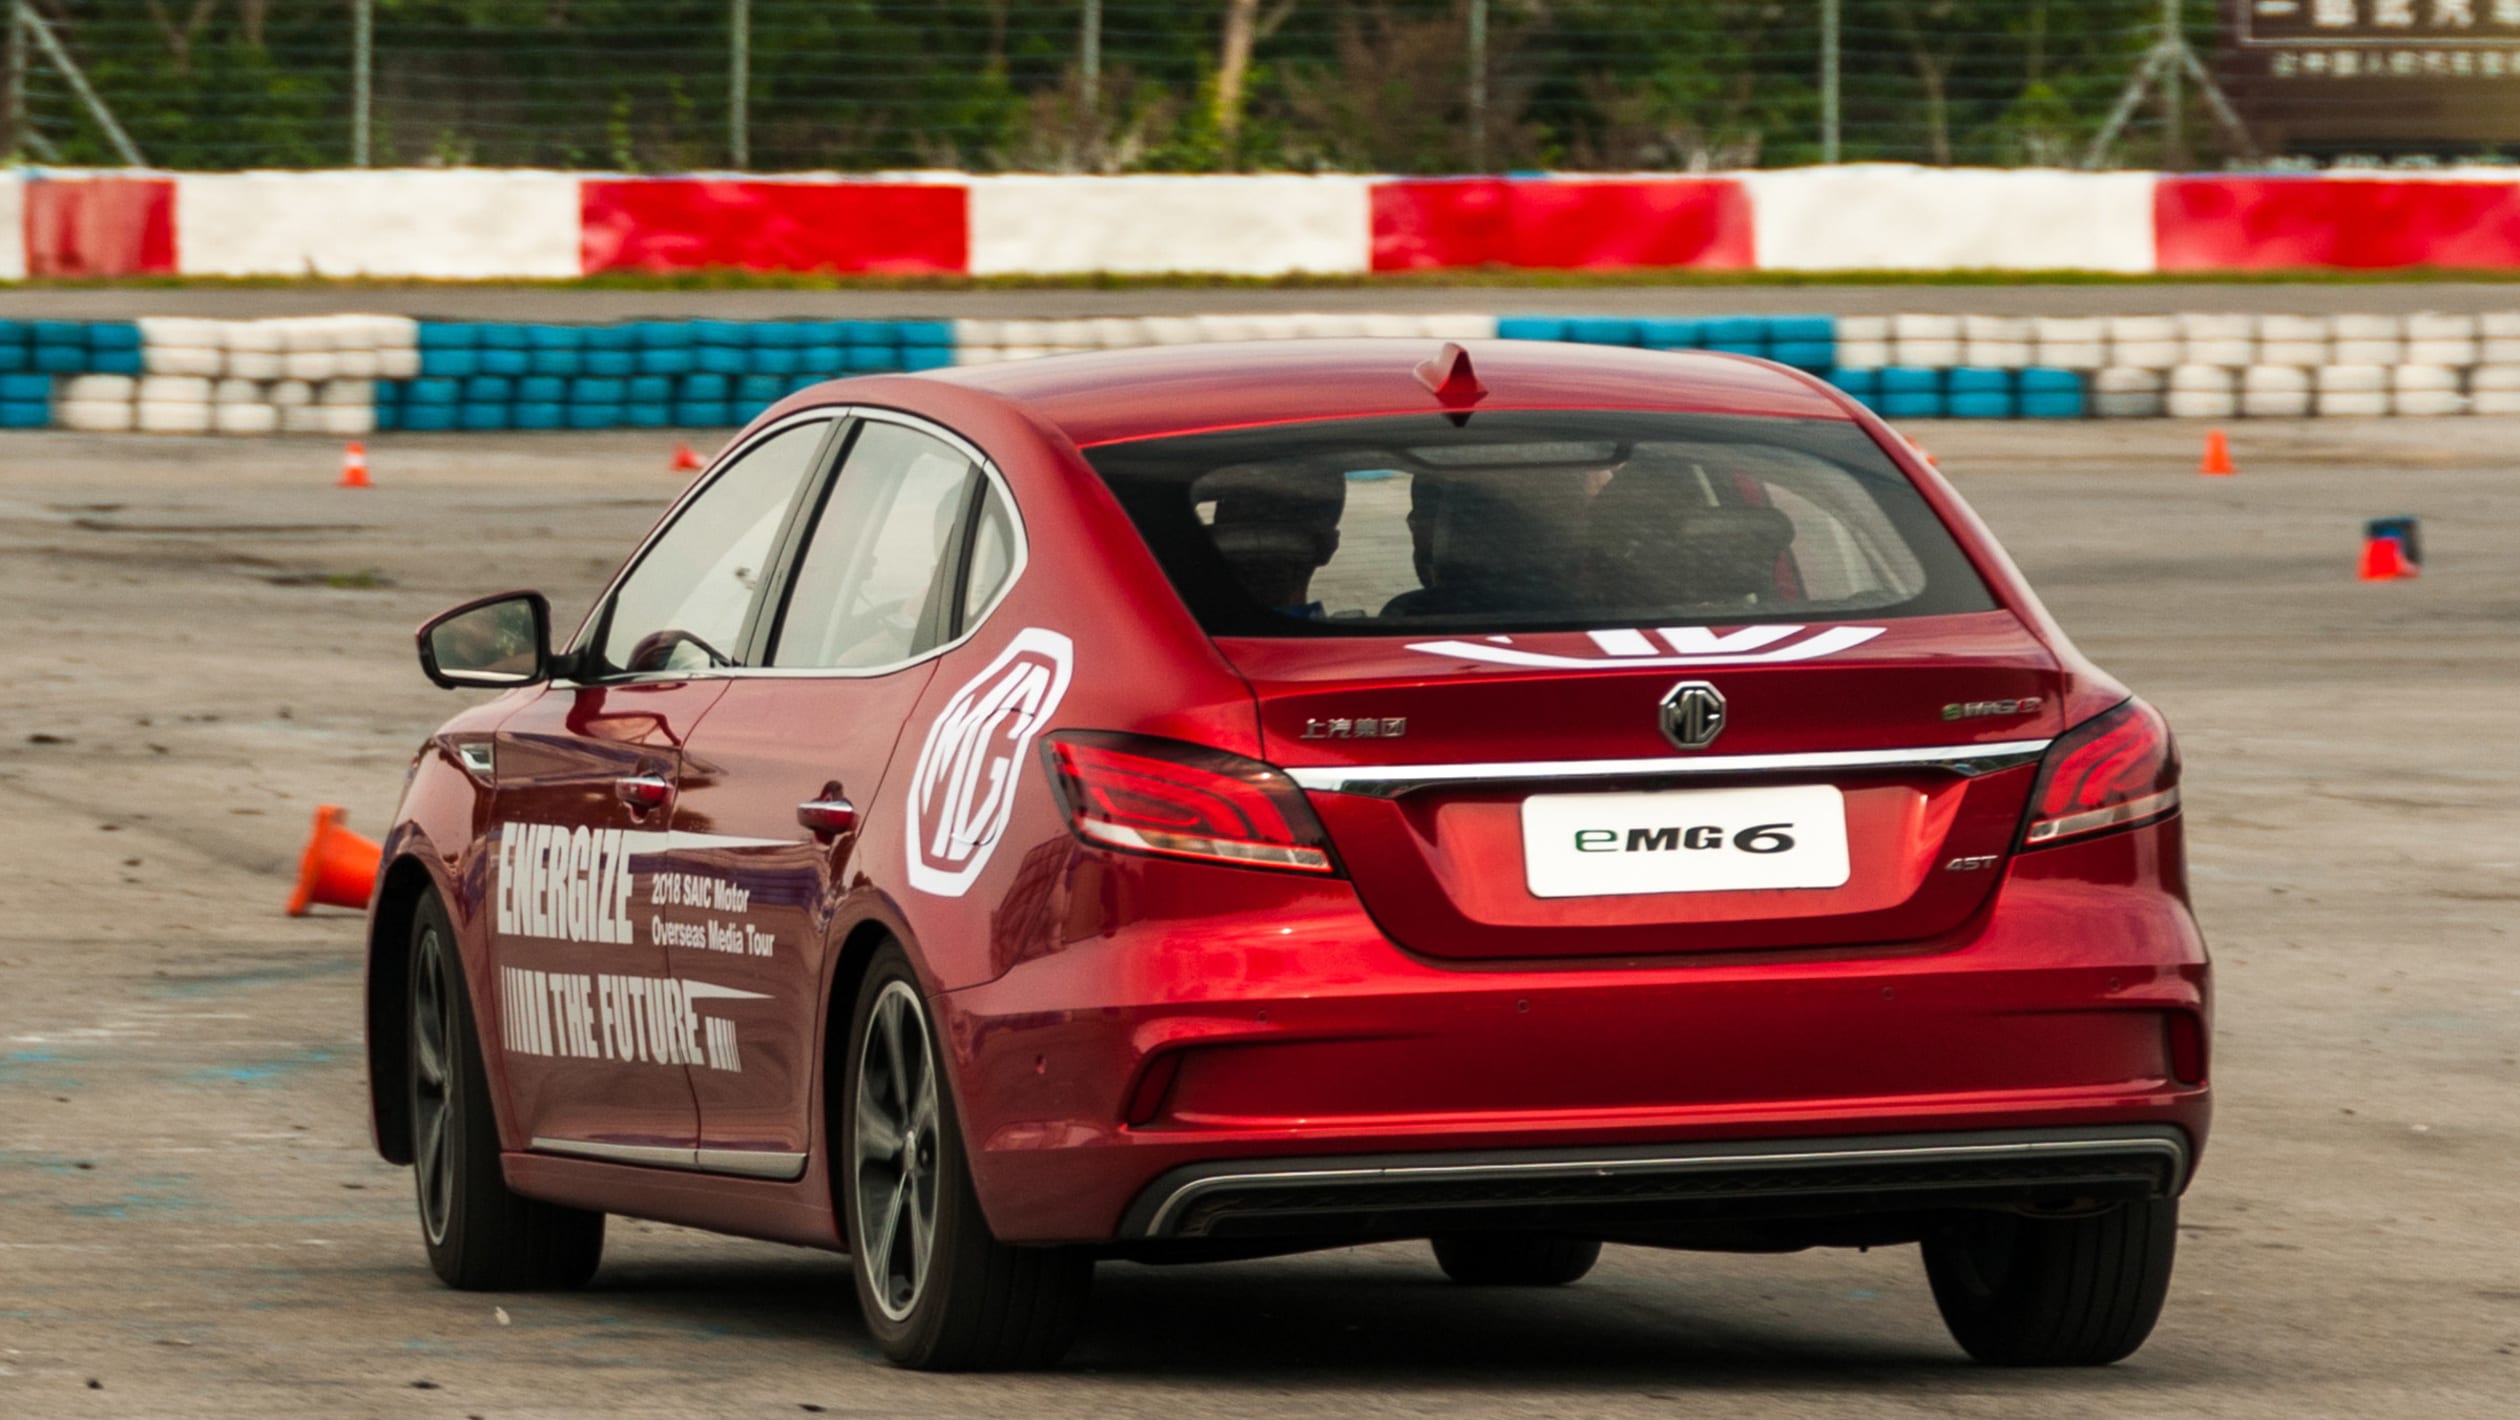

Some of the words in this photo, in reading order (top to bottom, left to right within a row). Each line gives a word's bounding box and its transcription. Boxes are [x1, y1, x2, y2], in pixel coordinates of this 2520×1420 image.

[1299, 717, 1407, 739] 上汽集团
[1665, 688, 1721, 744] MG
[922, 661, 1050, 861] MG
[497, 821, 634, 945] ENERGIZE
[1944, 854, 1999, 871] 45T
[651, 872, 681, 906] 2018
[682, 875, 711, 909] SAIC
[714, 878, 750, 912] Motor
[651, 914, 706, 948] Overseas
[708, 919, 744, 954] Media
[745, 923, 775, 957] Tour
[549, 972, 599, 1059] THE
[598, 973, 705, 1065] FUTURE
